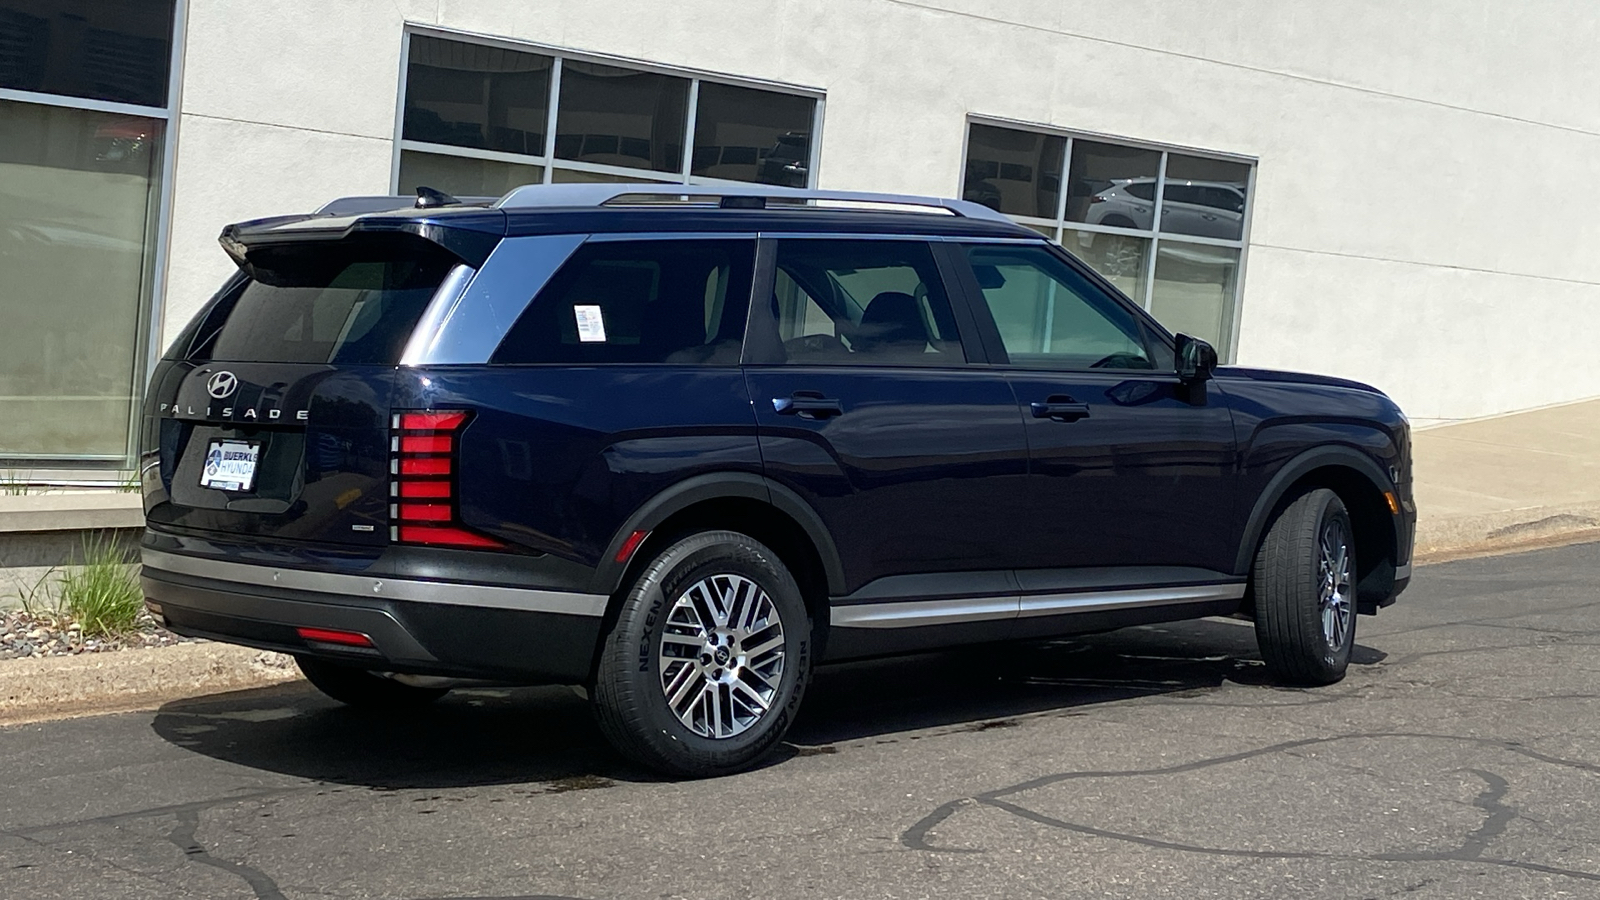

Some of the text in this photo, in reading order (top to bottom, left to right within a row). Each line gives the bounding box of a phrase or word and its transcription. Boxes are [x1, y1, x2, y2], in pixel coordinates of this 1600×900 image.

[160, 403, 310, 420] PALISADE
[639, 599, 663, 672] NEXEN
[788, 640, 807, 713] NEXEN
